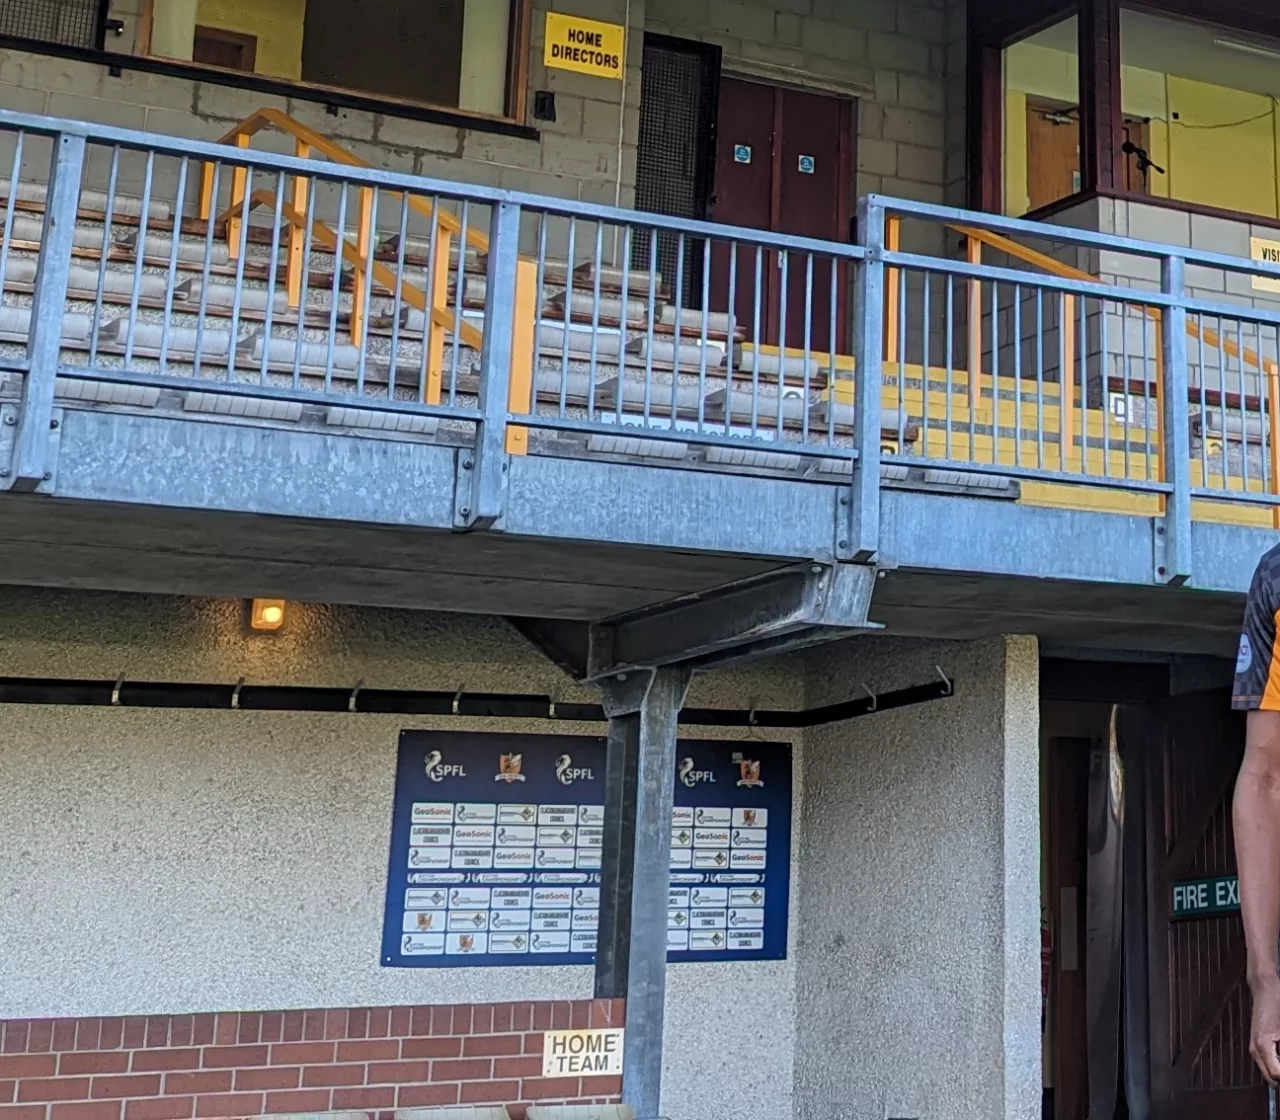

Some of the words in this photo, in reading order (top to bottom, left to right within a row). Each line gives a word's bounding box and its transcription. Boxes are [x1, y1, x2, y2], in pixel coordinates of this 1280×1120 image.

[567, 28, 603, 48] HOME
[551, 43, 619, 69] DIRECTORS
[436, 764, 467, 777] SPFL
[565, 768, 595, 780] SPFL
[688, 771, 717, 783] SPFL
[1173, 883, 1208, 911] FIRE
[1216, 880, 1241, 906] EXI
[552, 1034, 616, 1055] HOME
[556, 1054, 609, 1073] TEAM
